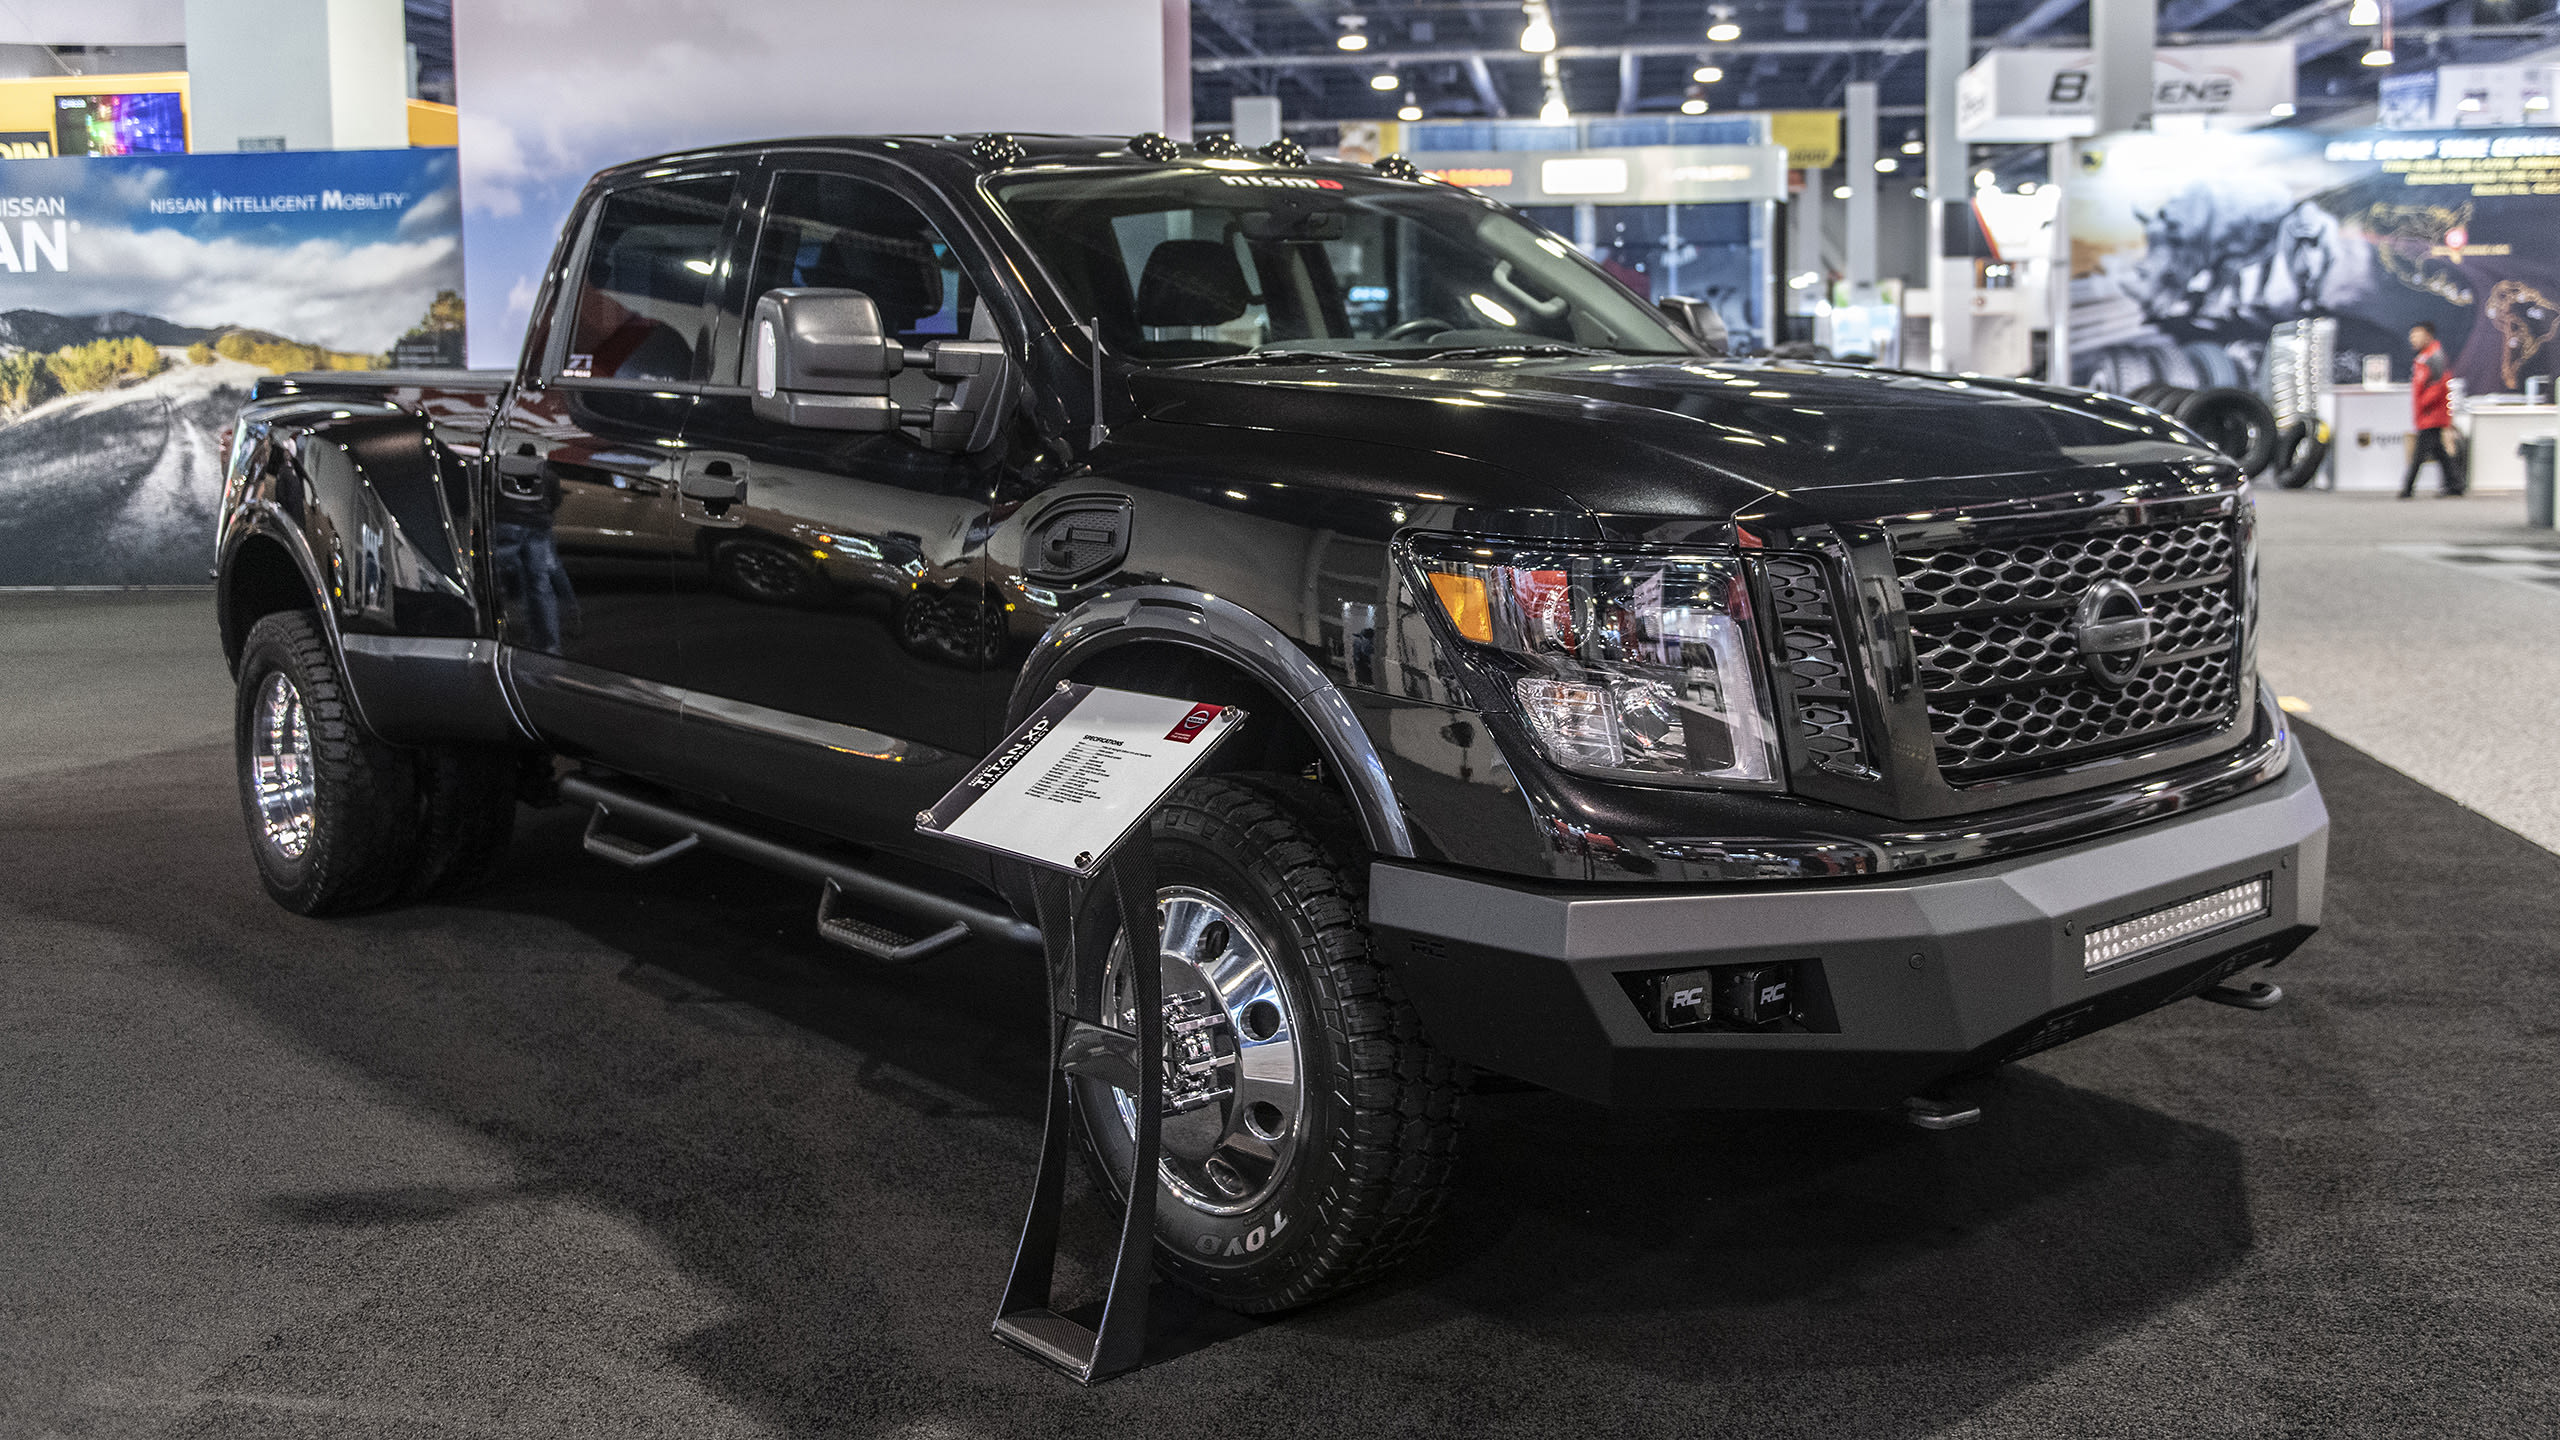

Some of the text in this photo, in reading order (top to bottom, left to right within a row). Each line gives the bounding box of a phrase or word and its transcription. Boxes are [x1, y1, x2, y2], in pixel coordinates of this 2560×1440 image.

[150, 189, 405, 214] NISSAN INTELLIGENT MOBILITY
[972, 743, 1025, 787] TITAN
[1021, 719, 1049, 742] XD
[1082, 734, 1125, 747] SPECIFICATIONS
[982, 761, 1014, 789] DUALLY
[1013, 727, 1050, 761] PROJECT
[1672, 987, 1704, 1009] RC
[1760, 982, 1787, 1005] RC
[1194, 1207, 1289, 1258] TOYO
